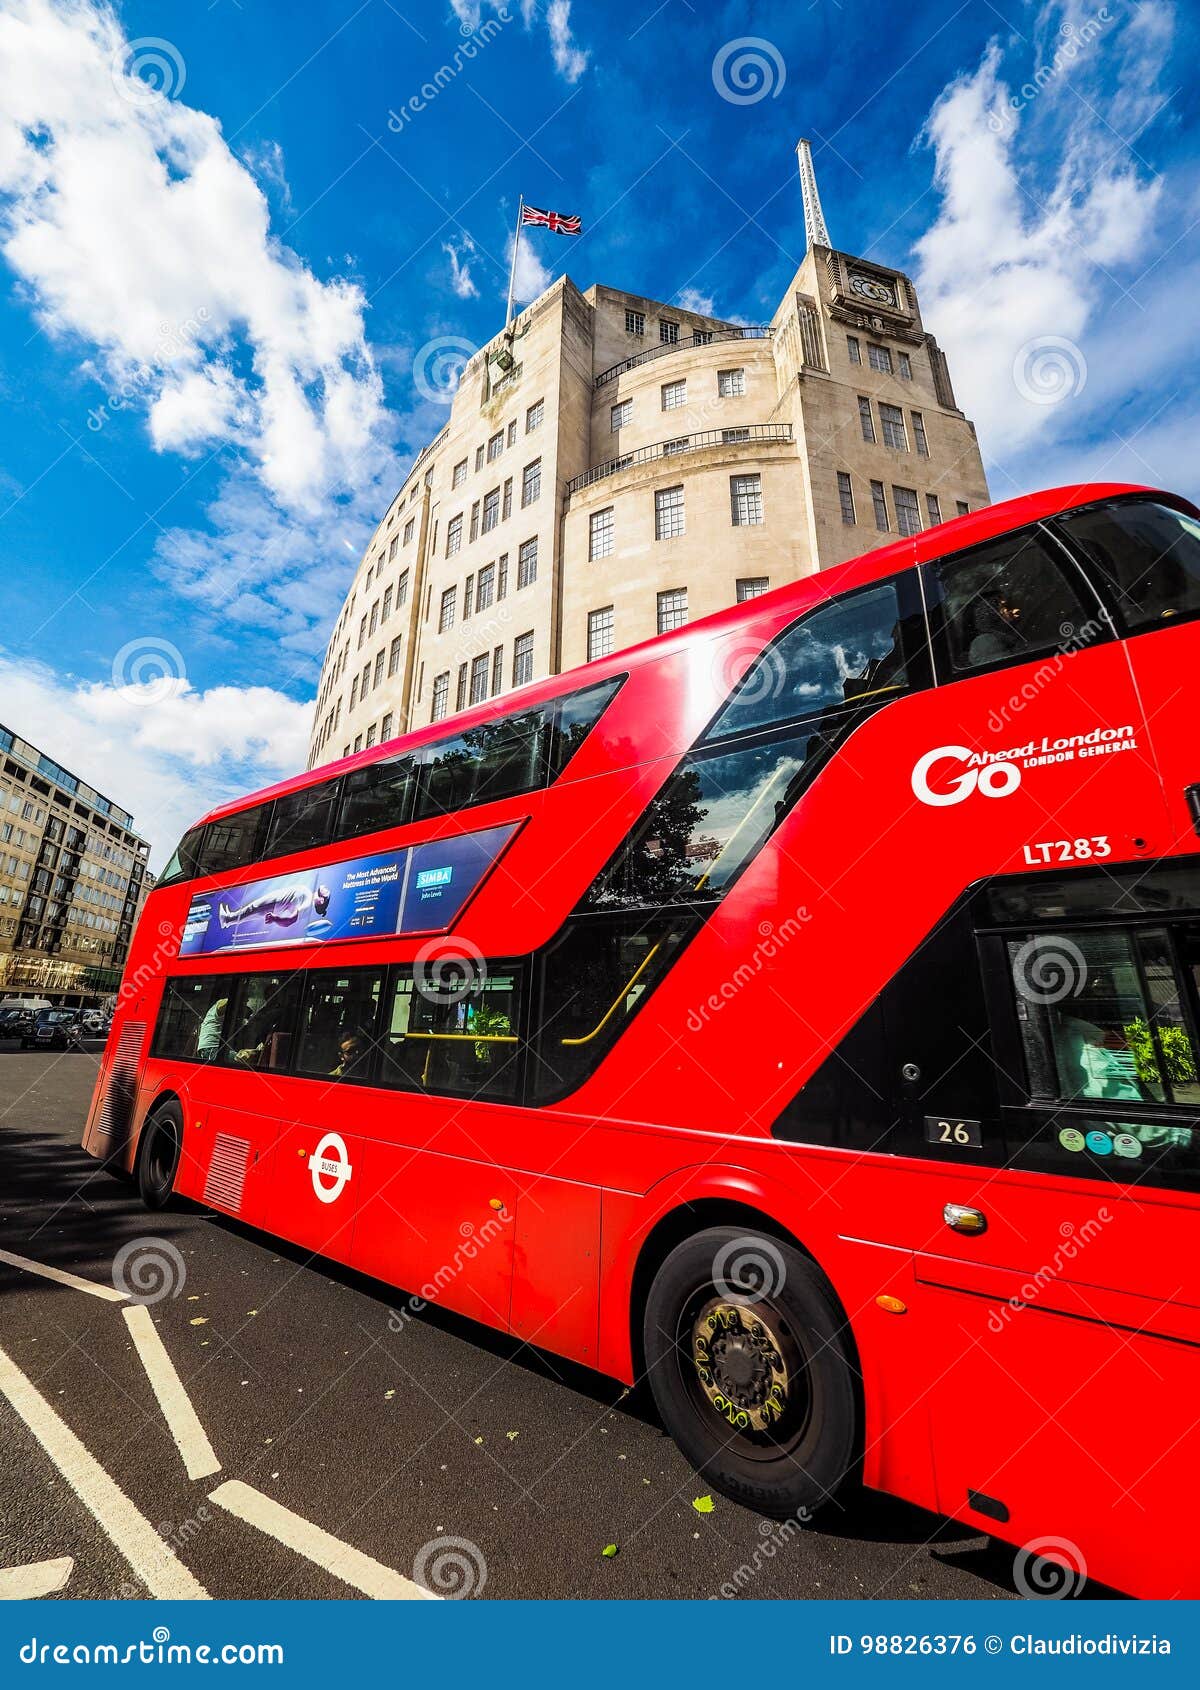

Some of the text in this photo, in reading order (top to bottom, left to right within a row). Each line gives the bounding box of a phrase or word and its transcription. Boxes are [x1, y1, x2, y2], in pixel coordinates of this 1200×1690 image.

[967, 725, 1133, 767] Ahead-London
[1023, 739, 1138, 768] LONDON GENERAL
[1023, 836, 1111, 864] LT283
[356, 871, 369, 879] Most
[369, 864, 397, 876] Advanced
[381, 871, 399, 882] World
[420, 871, 449, 885] SIMBA
[421, 892, 430, 900] John
[938, 1121, 970, 1144] 26
[321, 1161, 338, 1173] BUSES
